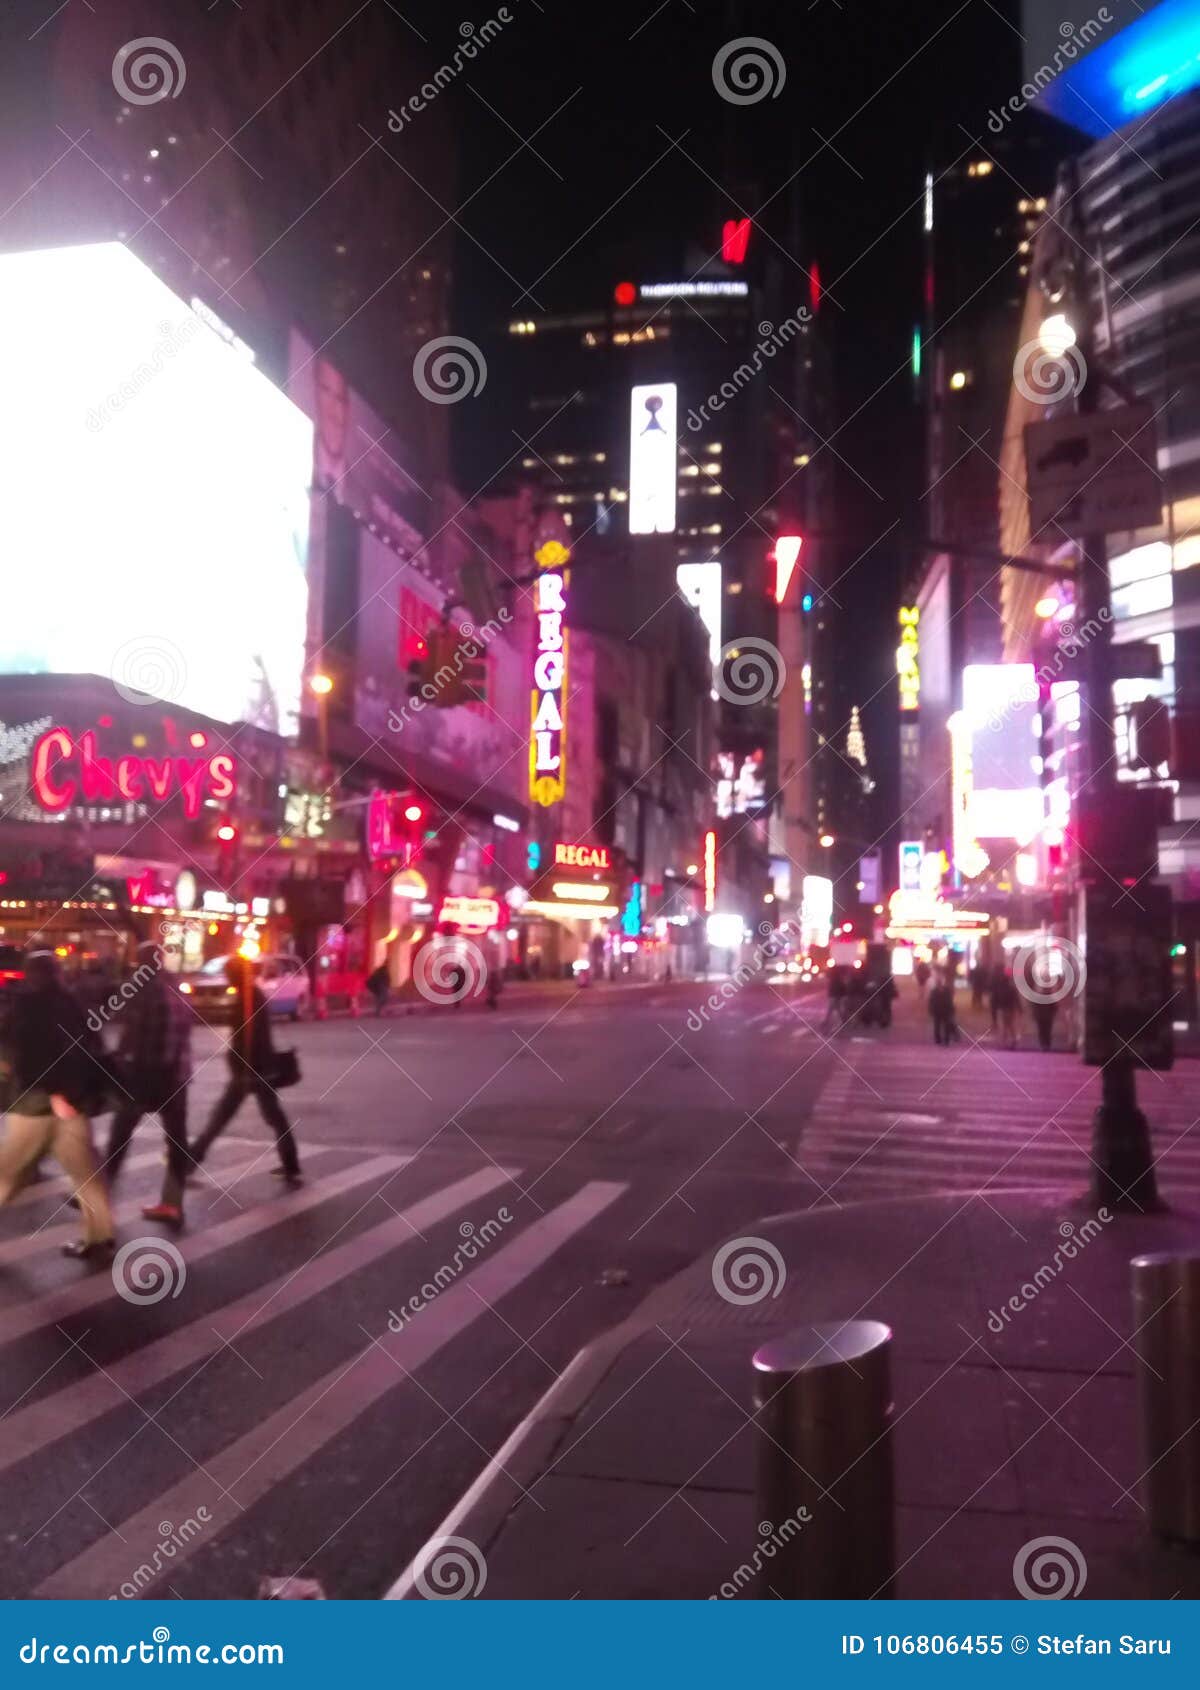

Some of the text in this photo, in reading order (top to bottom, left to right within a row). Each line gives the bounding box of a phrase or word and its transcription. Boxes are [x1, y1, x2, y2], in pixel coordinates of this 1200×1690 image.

[532, 573, 567, 771] REGAL
[32, 726, 237, 820] Chevys
[555, 843, 610, 868] REGAL
